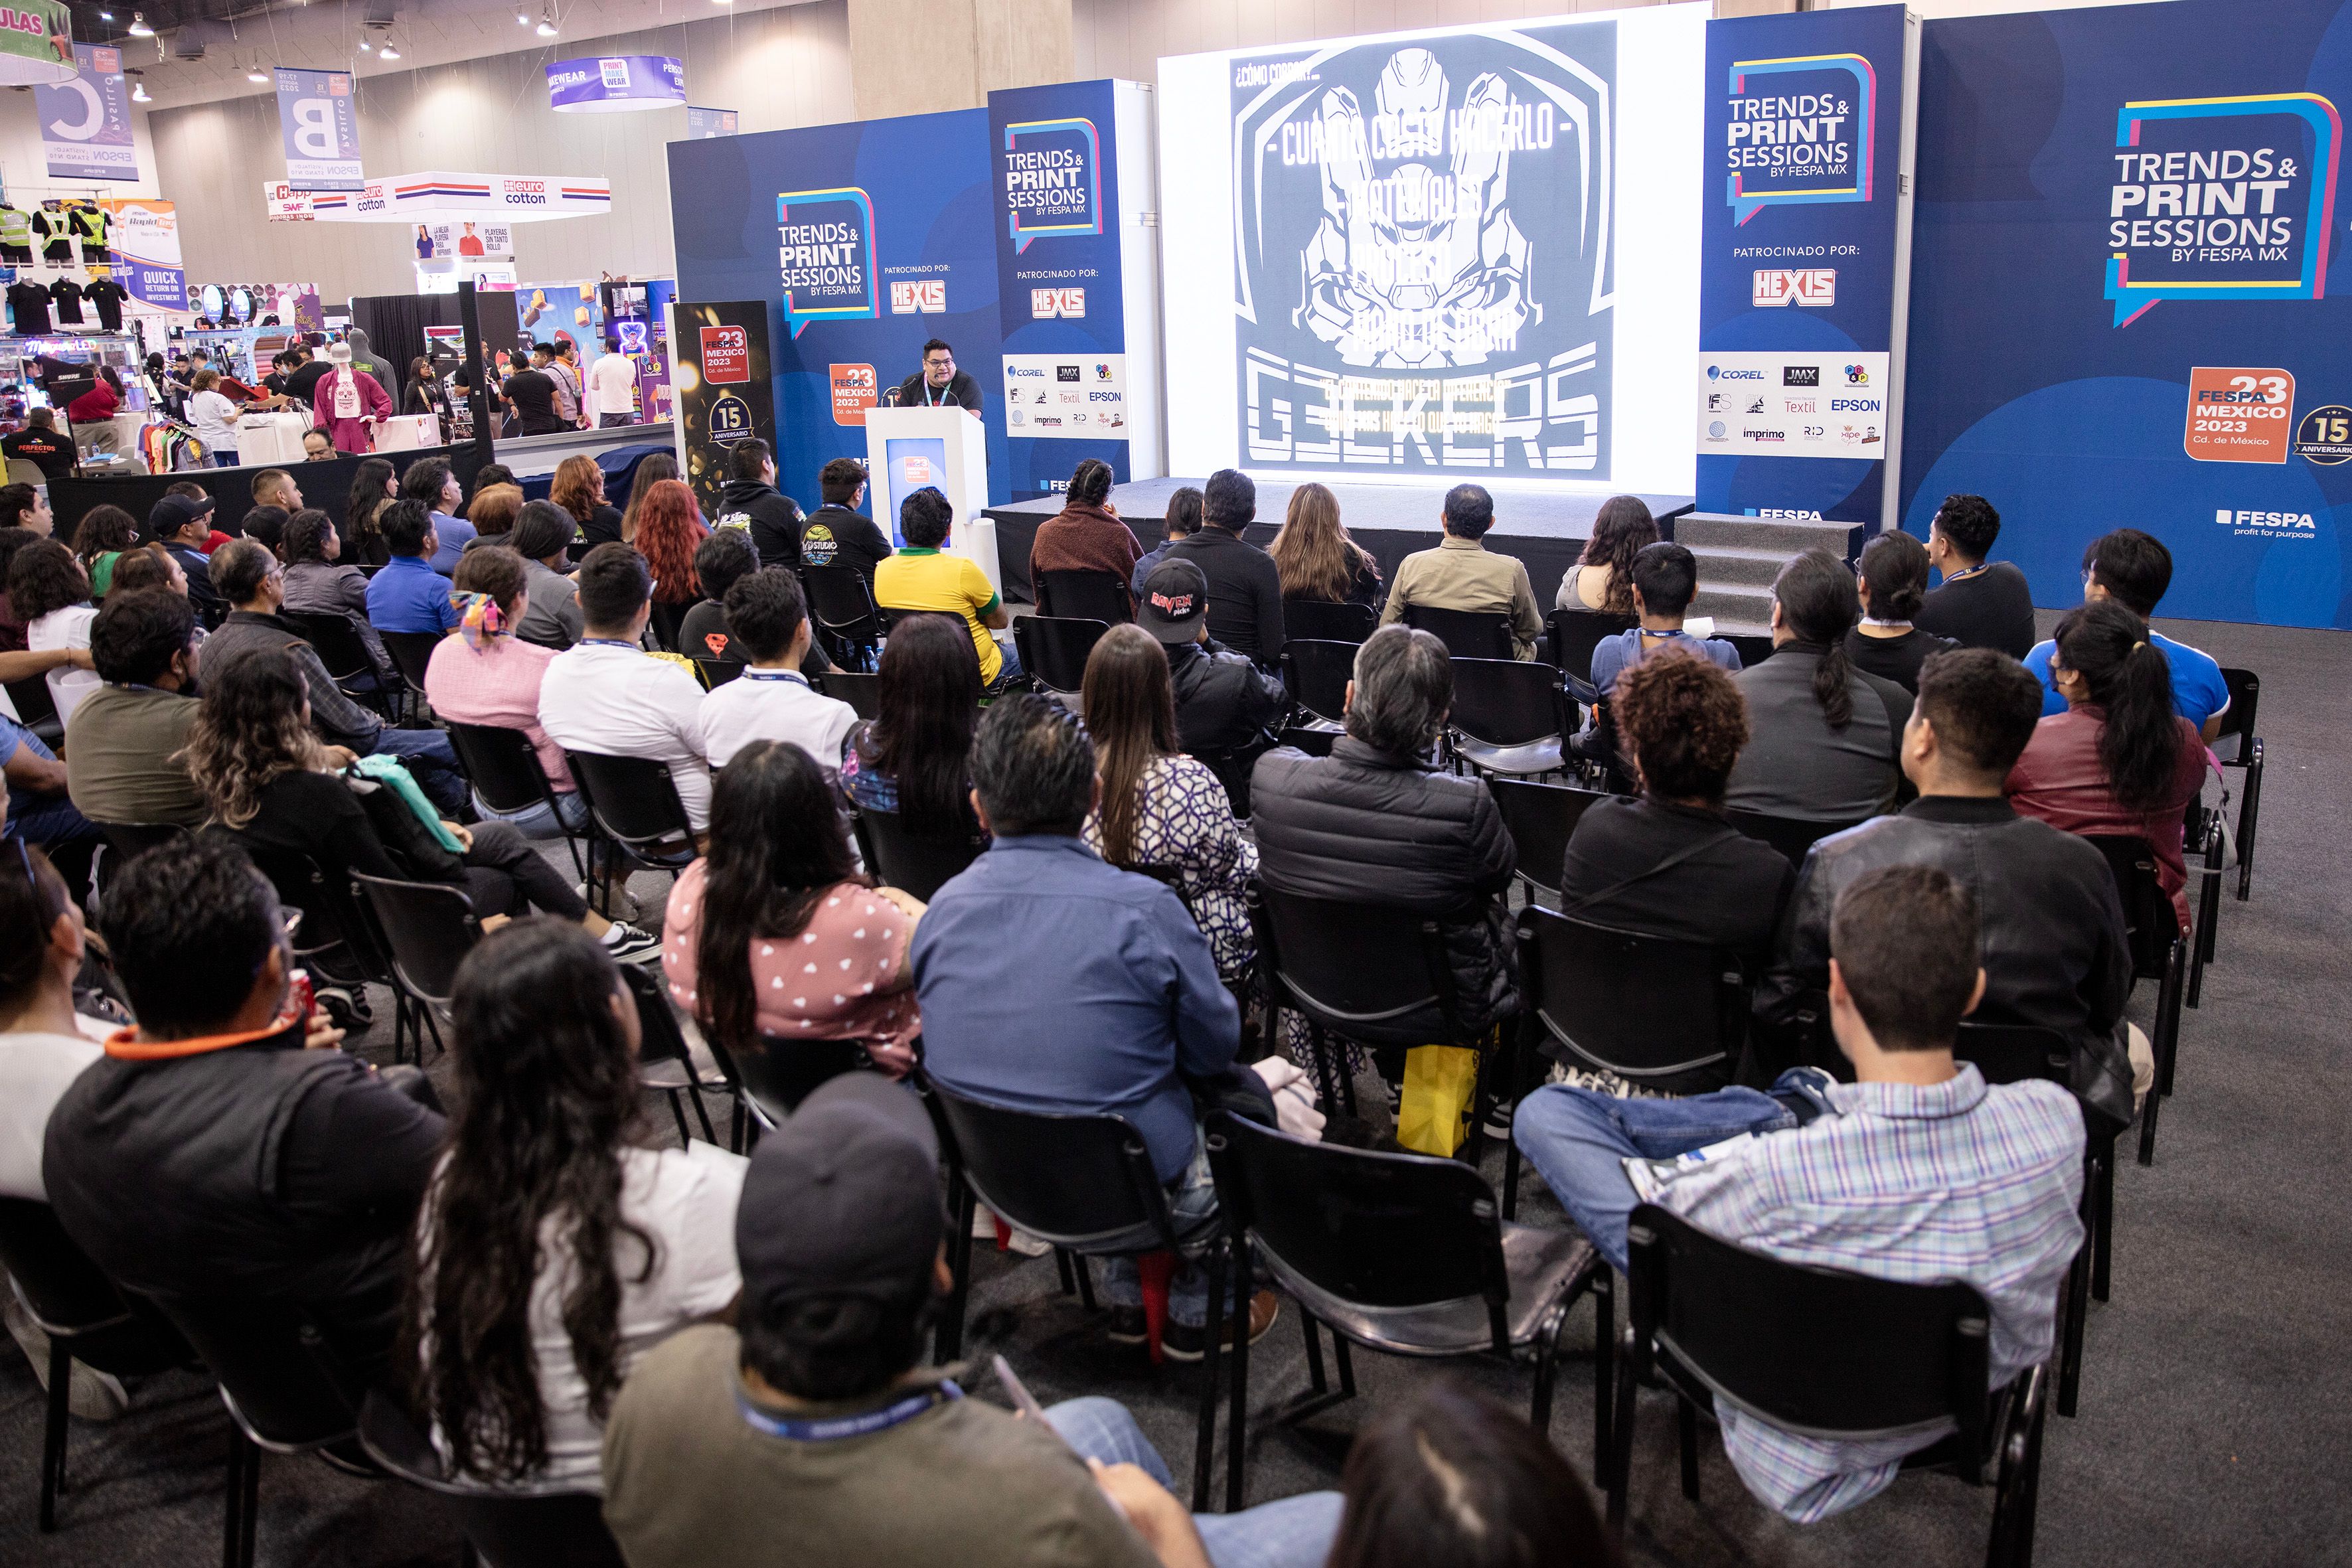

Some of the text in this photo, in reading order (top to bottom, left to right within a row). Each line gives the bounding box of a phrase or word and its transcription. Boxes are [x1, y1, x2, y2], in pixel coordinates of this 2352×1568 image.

[603, 61, 623, 70] PRINT
[1235, 62, 1267, 88] ¿CÓMO
[606, 78, 627, 86] WEAR
[1729, 94, 1849, 121] TRENDS &
[1372, 102, 1553, 160] COSTO HACERLO
[1727, 116, 1845, 147] PRINT
[1006, 149, 1083, 171] TRENDS &
[1727, 142, 1848, 168] SESSIONS
[1770, 164, 1847, 177] BY FESPA MX
[2114, 149, 2298, 183] TRENDS &
[1006, 167, 1081, 191] PRINT
[364, 186, 382, 198] euro
[516, 181, 544, 192] euro
[506, 193, 546, 204] cotton
[1008, 187, 1085, 208] SESSIONS
[2110, 181, 2290, 217] PRINT
[357, 199, 386, 212] cotton
[1036, 204, 1085, 216] BY FESPA MX
[778, 222, 858, 245] TRENDS &
[2108, 217, 2292, 248] SESSIONS
[779, 243, 856, 268] PRINT
[1734, 246, 1860, 258] PATROCINADO POR:
[2171, 248, 2288, 262] BY FESPA MX
[781, 266, 861, 287] SESSIONS
[885, 266, 932, 274] PATROCINADO
[1017, 270, 1075, 279] PATROCINADO
[143, 271, 179, 284] QUICK
[811, 285, 862, 296] BY FESPA MX
[1755, 271, 1834, 305] HEXIS
[892, 281, 944, 312] HEXIS
[1033, 289, 1085, 317] HEXIS
[706, 340, 736, 349] FESPA
[718, 331, 744, 348] 23
[706, 348, 745, 358] MEXICO
[708, 358, 731, 366] 2023
[848, 368, 874, 387] 23
[1059, 368, 1078, 376] JMX
[1721, 370, 1764, 380] COREL
[1787, 369, 1816, 380] JMX
[2198, 390, 2266, 403] FESPA
[2230, 376, 2288, 404] 23
[1059, 393, 1081, 404] Textil
[1089, 392, 1121, 402] EPSON
[1784, 401, 1816, 413] Textil
[1832, 400, 1881, 412] EPSON
[2196, 405, 2286, 419] MEXICO
[718, 406, 742, 429] 15
[1034, 414, 1062, 426] imprimo
[2195, 420, 2247, 433] 2023
[2315, 418, 2348, 443] 15
[714, 430, 748, 439] ANIVERSARIO
[1743, 426, 1784, 441] imprimo
[2231, 436, 2269, 445] México
[1050, 481, 1071, 491] FES
[2235, 510, 2315, 528] FESPA
[2261, 528, 2274, 536] for
[2276, 530, 2315, 539] purpose
[814, 541, 838, 550] STUDIO
[1151, 592, 1192, 614] RAVEN
[1173, 607, 1190, 617] picks
